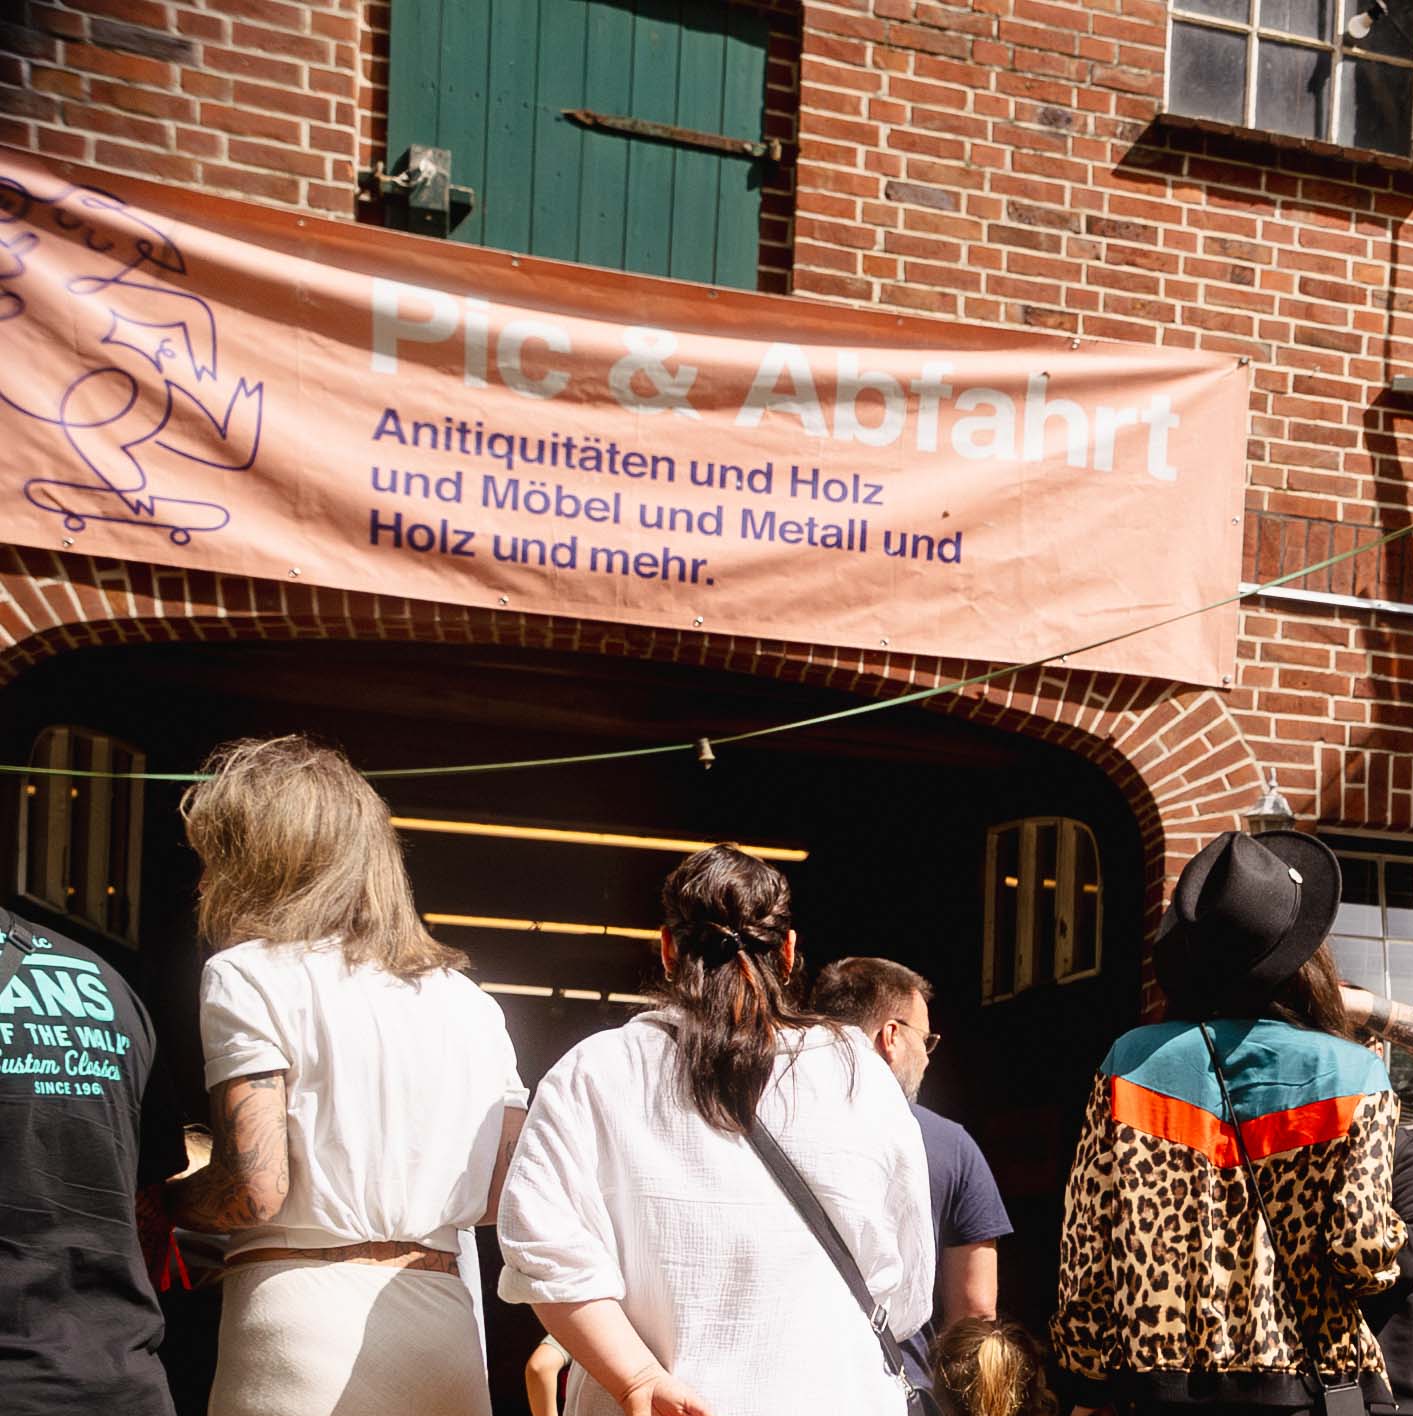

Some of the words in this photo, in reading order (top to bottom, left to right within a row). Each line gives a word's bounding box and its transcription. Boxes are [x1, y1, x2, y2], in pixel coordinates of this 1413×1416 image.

[370, 277, 571, 400] Pic
[608, 326, 702, 420] &
[735, 342, 1180, 481] Abfahrt
[371, 407, 676, 483] Anitiquitäten
[689, 460, 773, 495] und
[790, 465, 884, 506] Holz
[369, 508, 475, 558] Holz
[491, 534, 577, 570] und
[590, 547, 715, 586] mehr.
[371, 466, 463, 504] und
[481, 475, 621, 525] Möbel
[639, 503, 723, 537] und
[740, 508, 867, 553] Metall
[883, 530, 963, 564] und
[0, 968, 115, 1022] ANS
[0, 1049, 60, 1075] ustom
[24, 1022, 73, 1047] THE
[34, 1081, 71, 1095] SINCE
